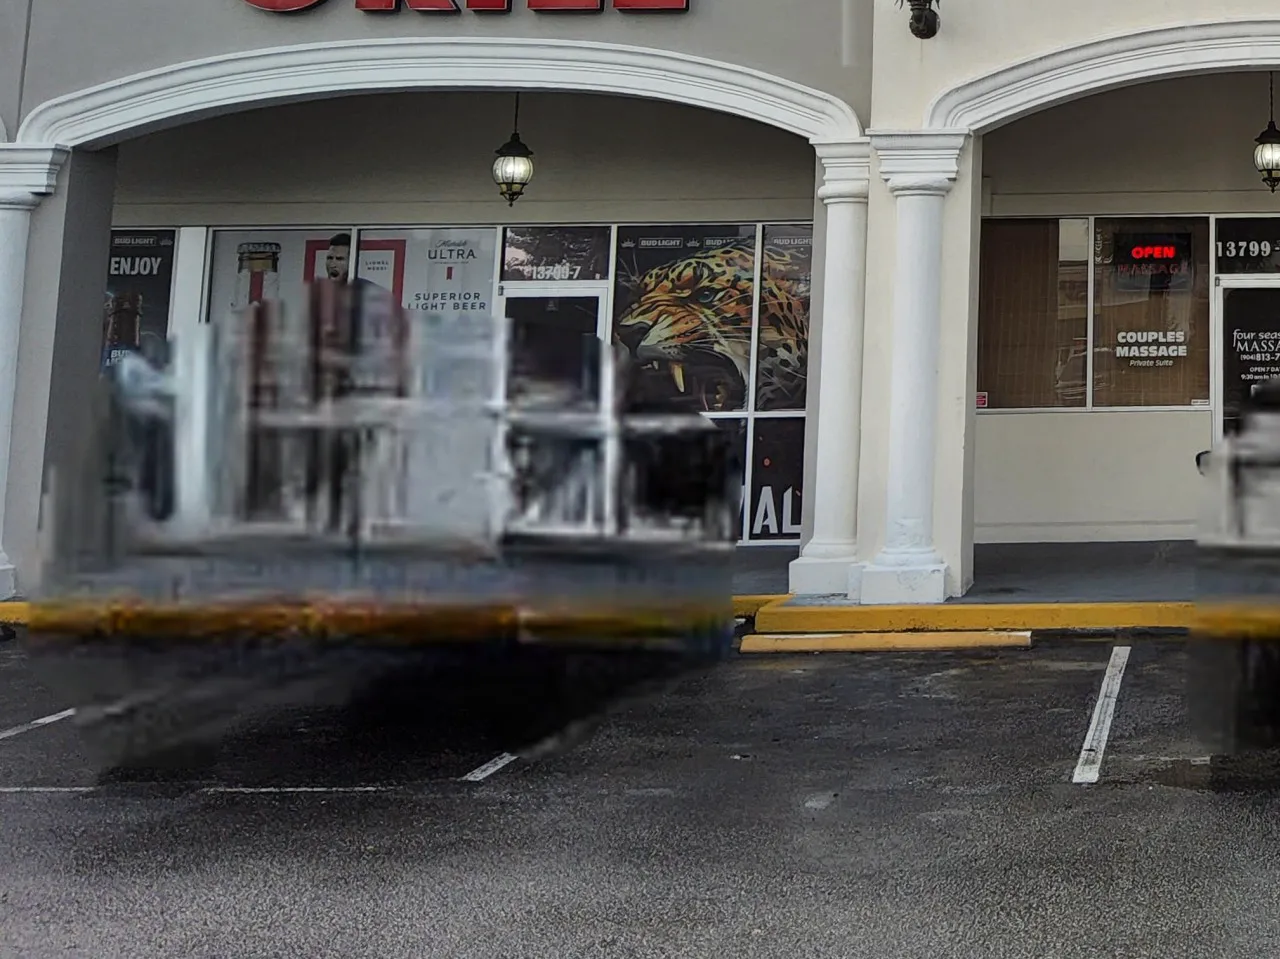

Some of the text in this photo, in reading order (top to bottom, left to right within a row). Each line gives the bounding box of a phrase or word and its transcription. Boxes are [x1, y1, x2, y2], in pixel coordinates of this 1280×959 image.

[428, 249, 476, 260] ULTRA
[1131, 246, 1175, 259] OPEN
[110, 257, 161, 275] ENJOY
[415, 292, 480, 301] SUPERIOR
[453, 302, 486, 310] BEER
[1117, 331, 1185, 343] COUPLES
[1233, 329, 1255, 347] four
[1116, 346, 1187, 357] MASSAGE
